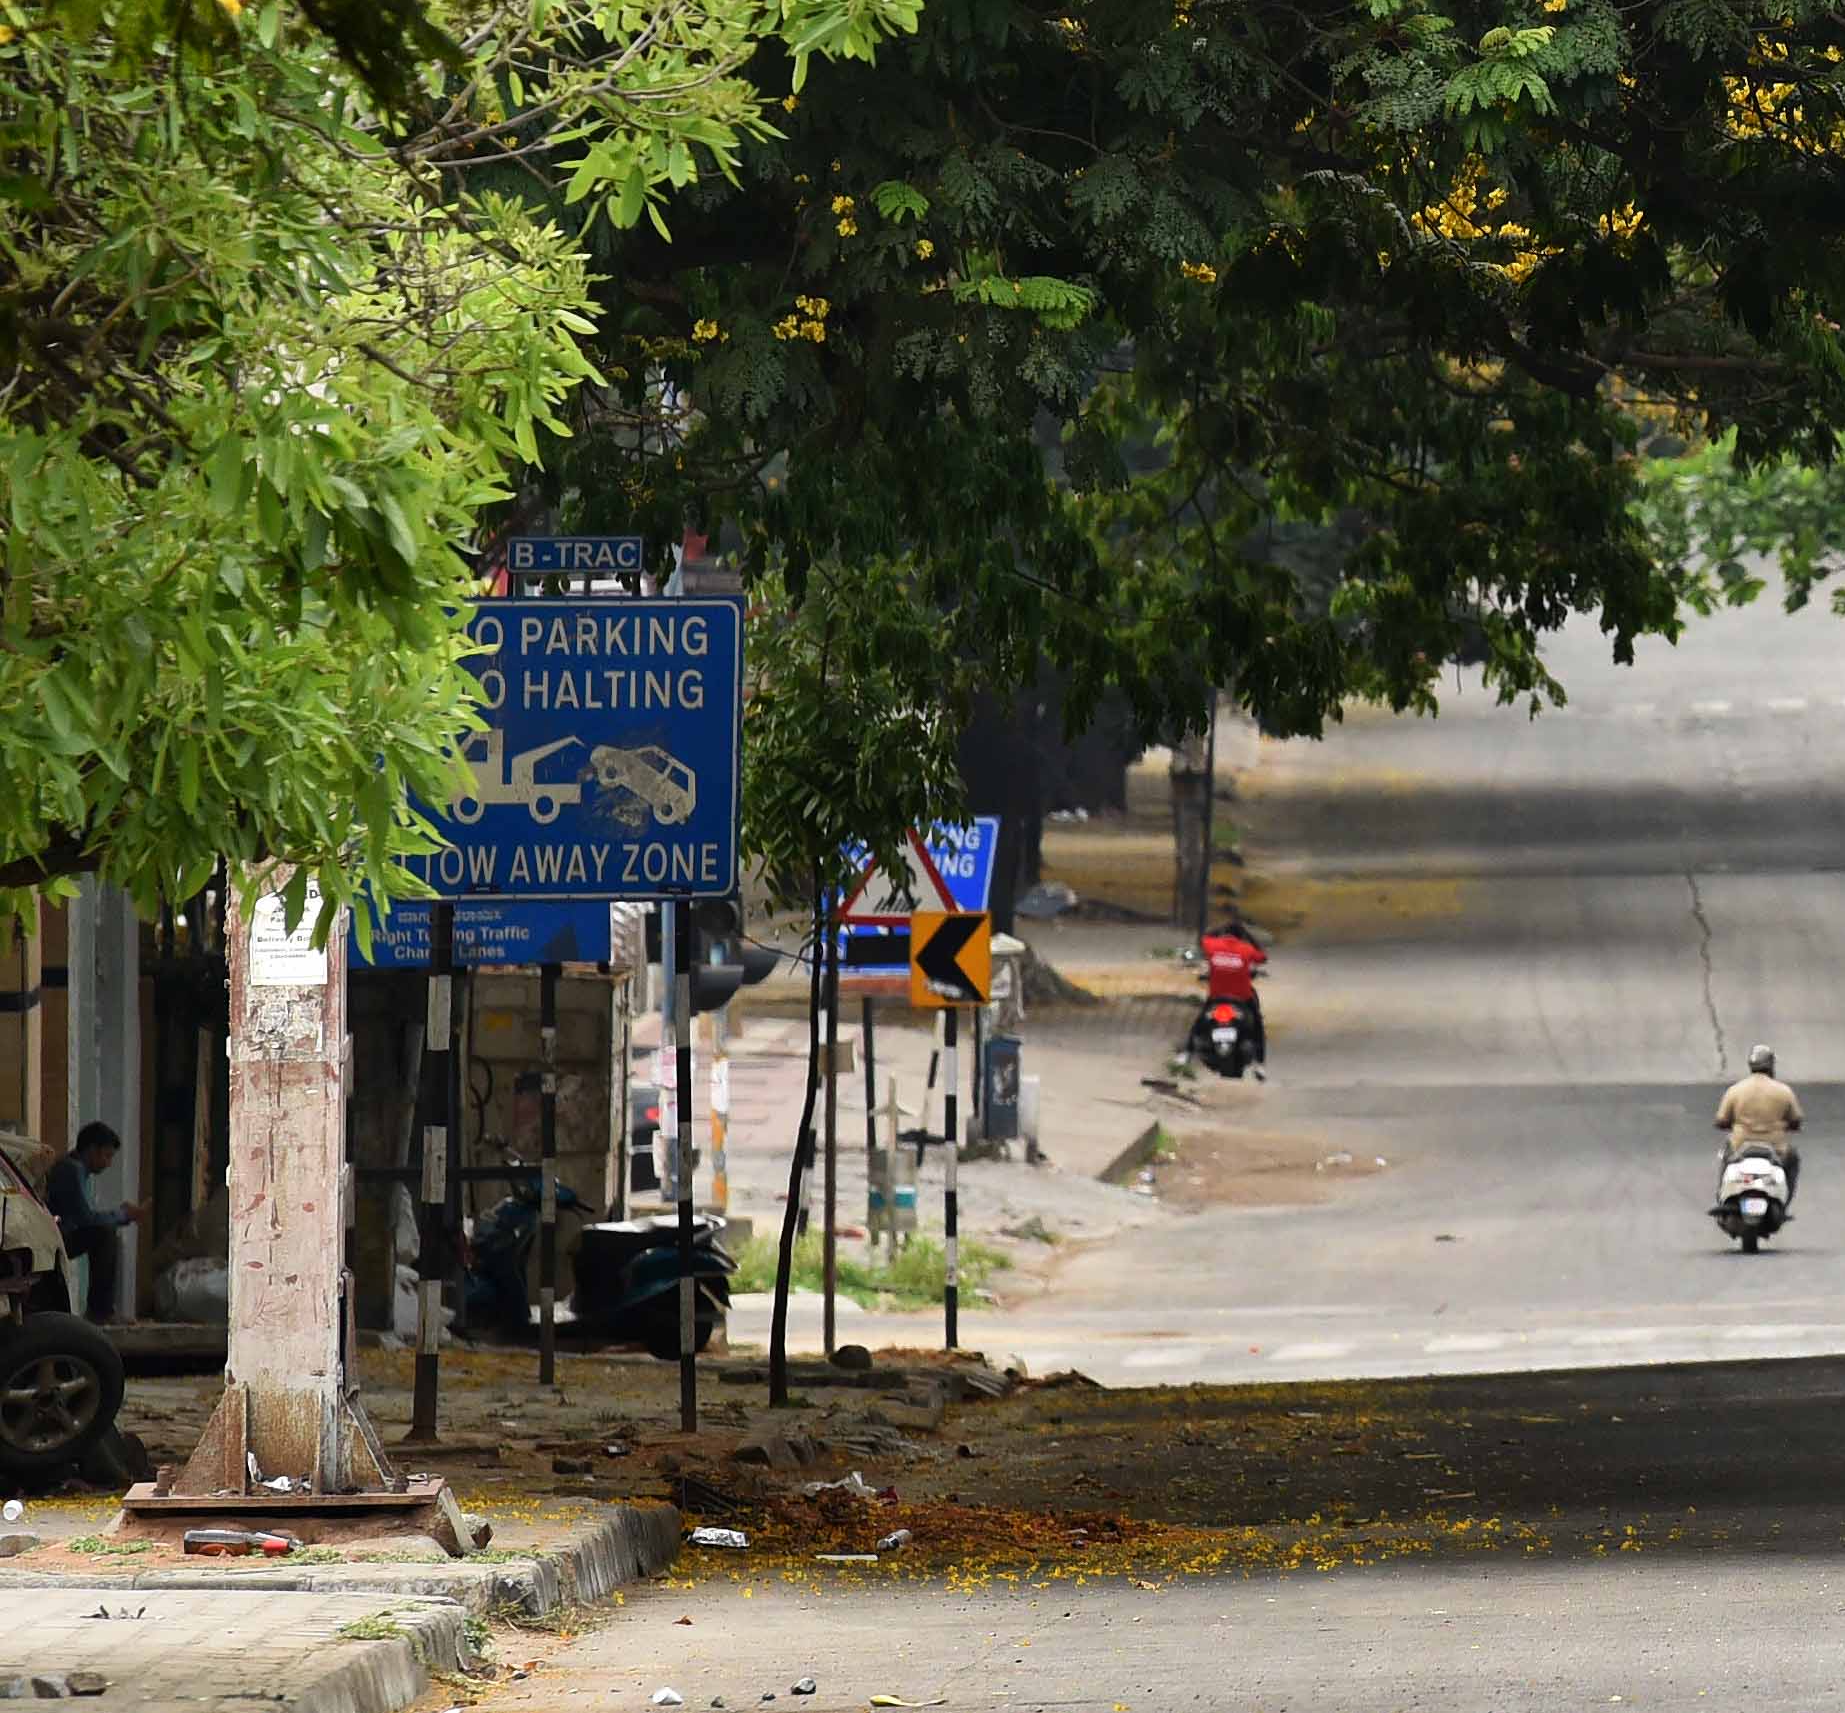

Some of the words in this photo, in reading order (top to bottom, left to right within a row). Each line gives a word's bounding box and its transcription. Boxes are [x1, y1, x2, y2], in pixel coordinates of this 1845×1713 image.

[463, 616, 504, 656] O
[520, 616, 708, 656] PARKING
[523, 669, 705, 710] HALTING
[509, 843, 610, 884] AWAY
[621, 842, 719, 882] ZONE
[459, 945, 505, 960] Lanes
[480, 926, 529, 942] Traffic
